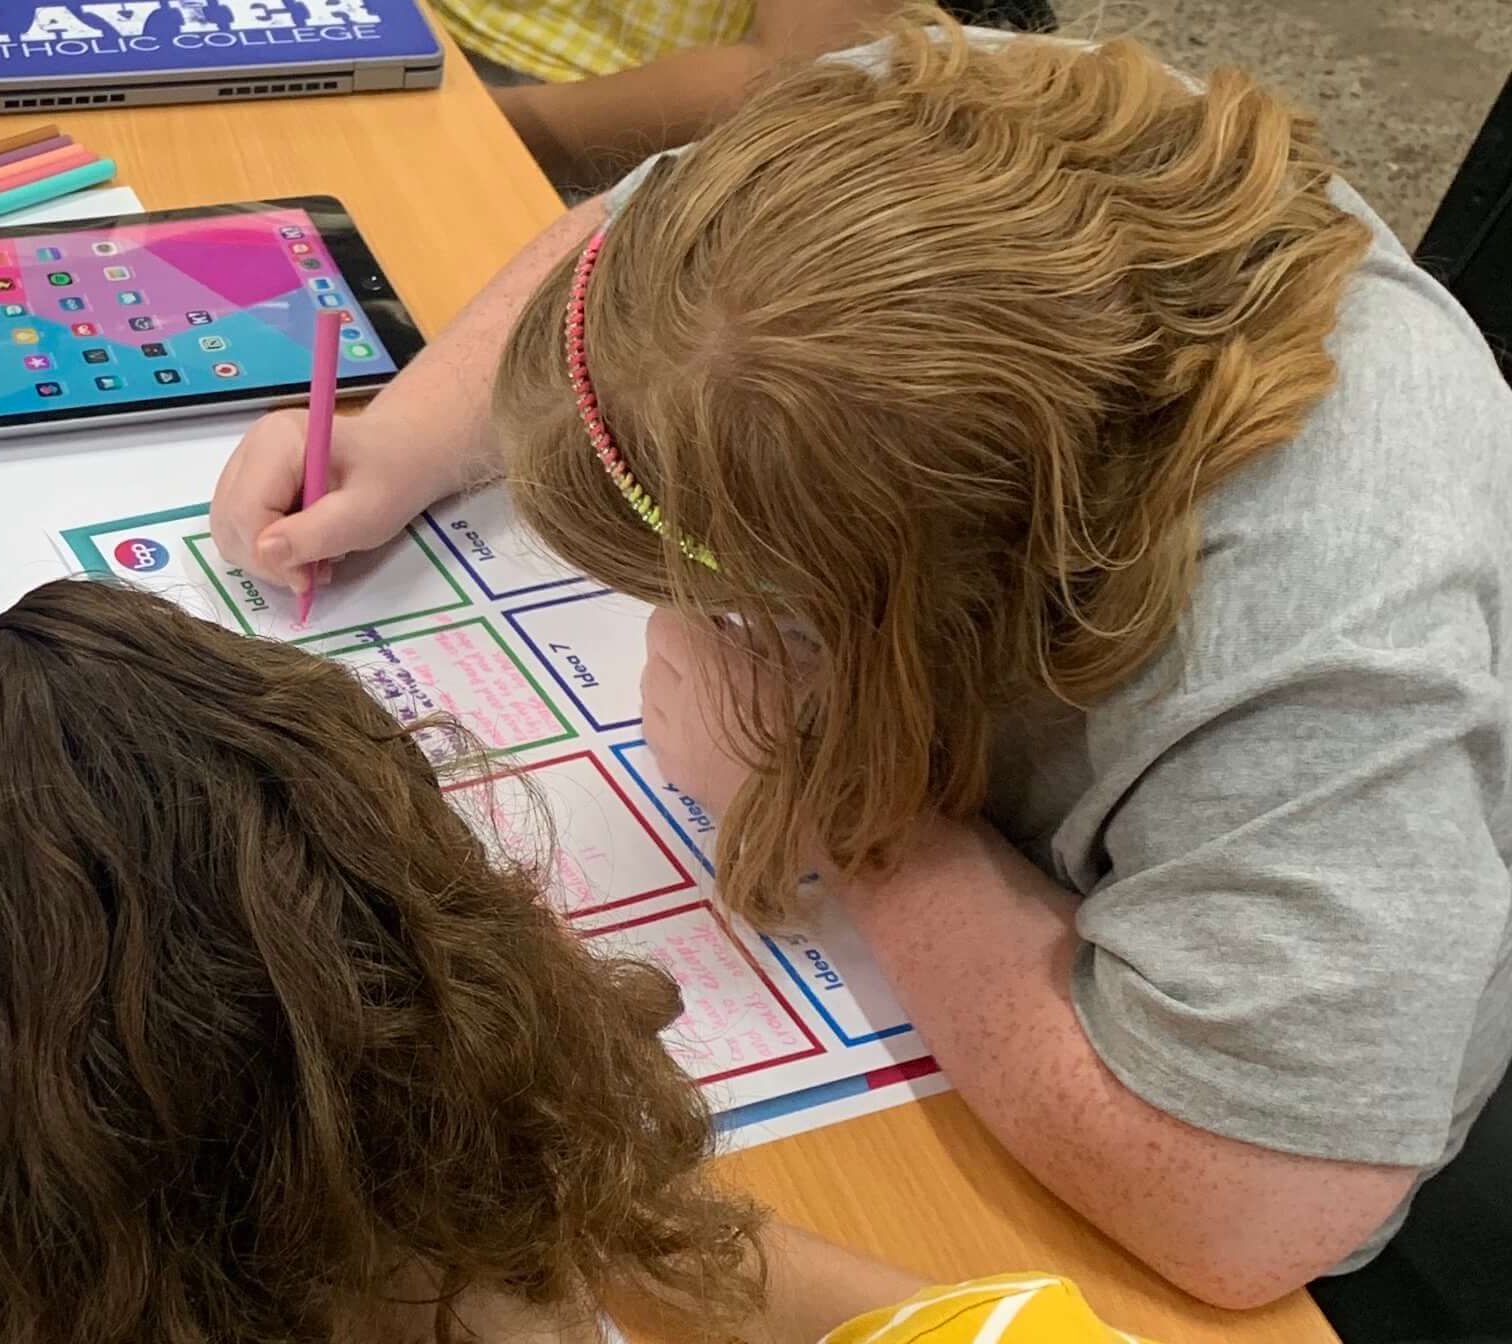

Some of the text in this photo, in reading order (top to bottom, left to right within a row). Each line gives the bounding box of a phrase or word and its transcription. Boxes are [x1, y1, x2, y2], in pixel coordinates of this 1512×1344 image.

[171, 23, 382, 51] COLLEGE
[449, 519, 496, 564] Idea 8
[226, 566, 270, 613] Idea 4
[547, 641, 600, 689] Idea 7
[678, 794, 717, 834] Idea
[804, 948, 845, 992] Idea
